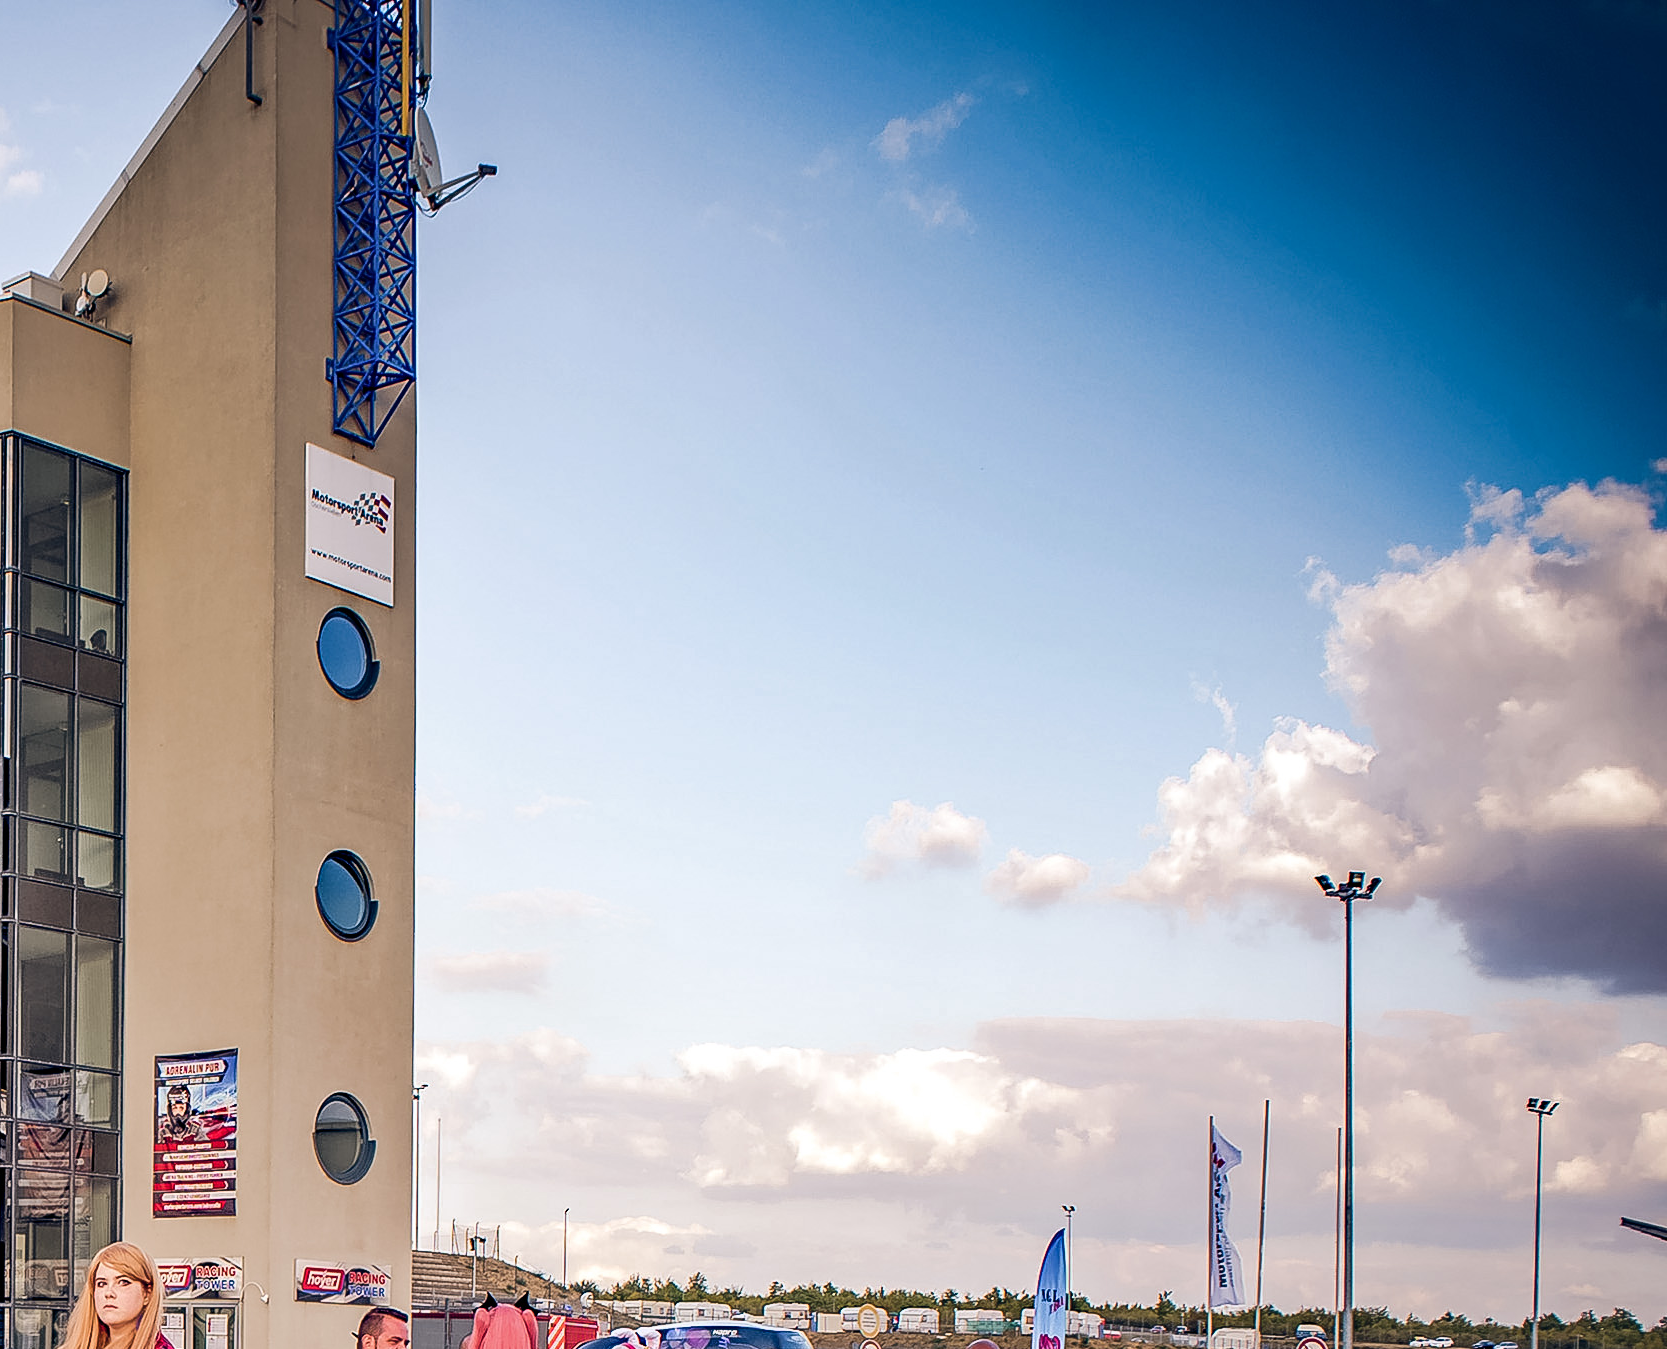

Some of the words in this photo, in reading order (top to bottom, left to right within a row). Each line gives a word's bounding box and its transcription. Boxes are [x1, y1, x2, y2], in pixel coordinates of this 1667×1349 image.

[311, 488, 359, 515] Motorsport
[360, 507, 385, 528] Arena
[165, 1063, 204, 1076] ADRENALIN
[205, 1062, 220, 1073] PUR
[160, 1270, 184, 1288] oyer
[195, 1265, 237, 1277] RACING
[307, 1272, 337, 1289] hoyer
[348, 1271, 386, 1285] RACING
[195, 1279, 236, 1291] TOWER
[348, 1285, 386, 1297] TOWER
